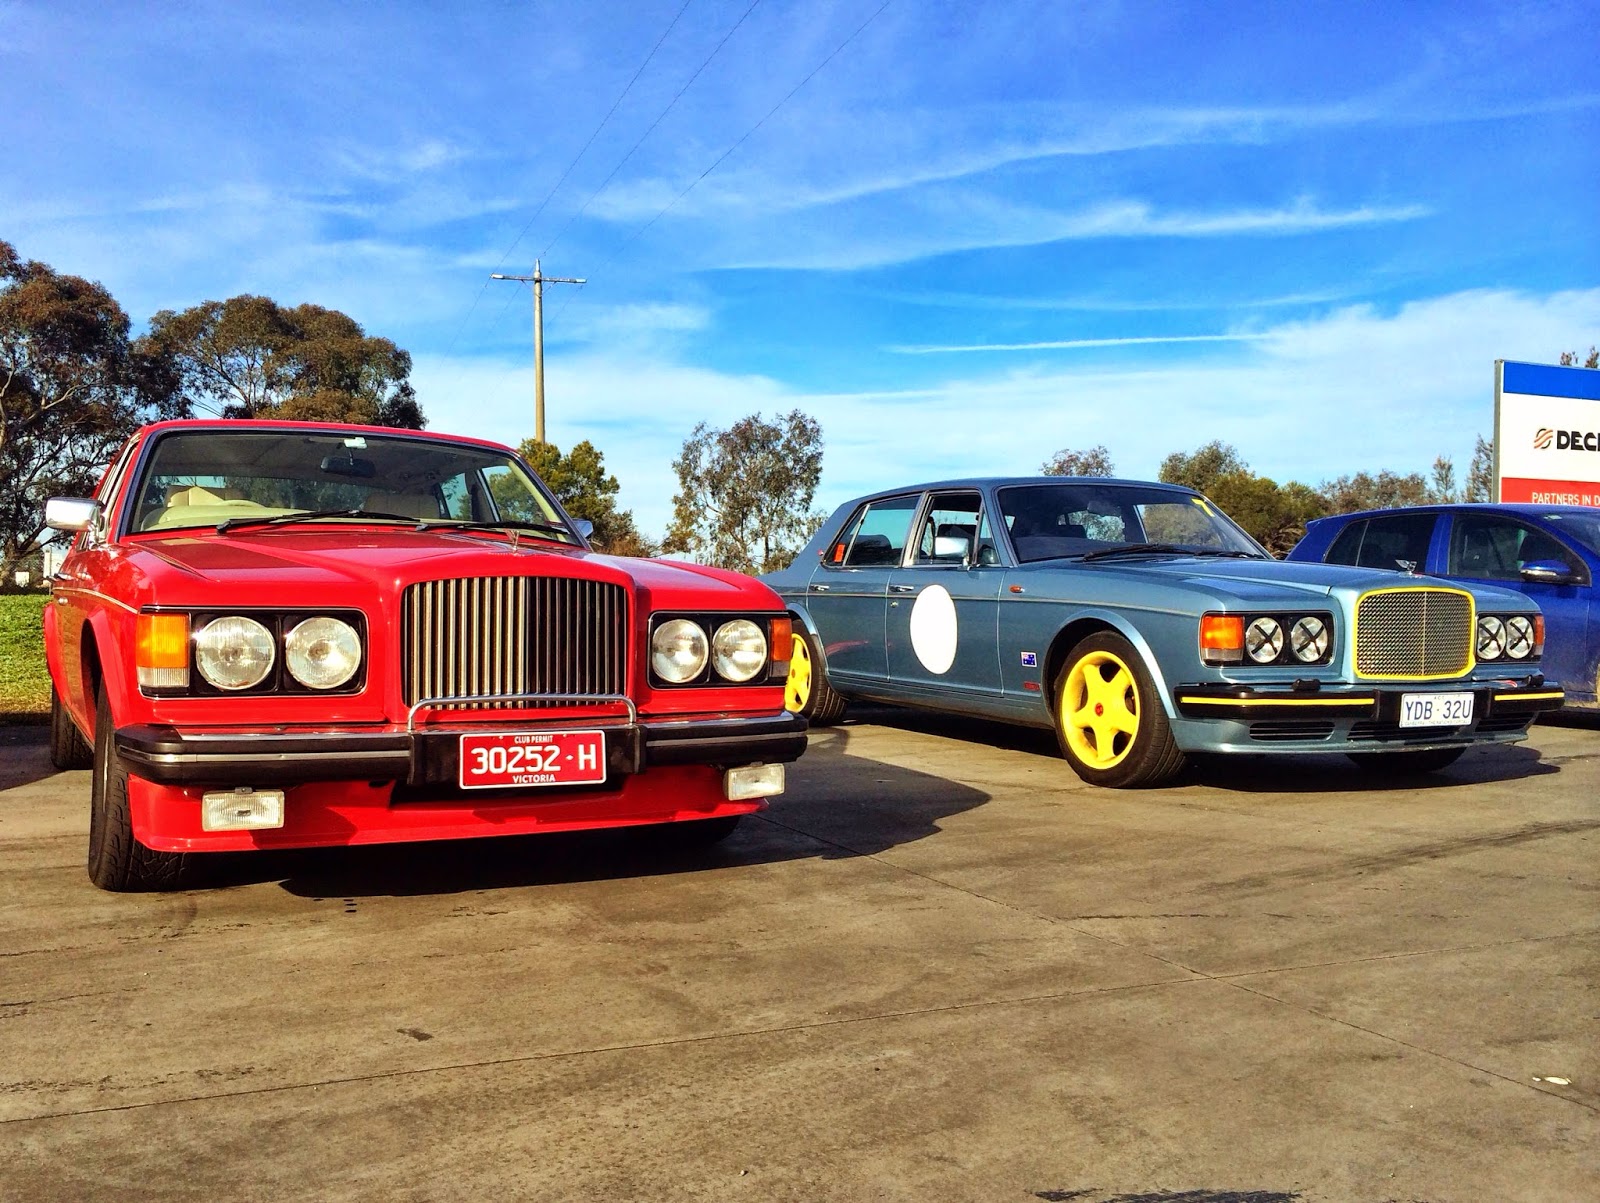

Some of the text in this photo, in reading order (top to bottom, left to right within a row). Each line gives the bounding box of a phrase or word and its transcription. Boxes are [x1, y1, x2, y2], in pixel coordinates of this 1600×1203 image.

[1557, 430, 1600, 452] DEC
[1532, 491, 1580, 506] PARTNERS
[1582, 494, 1592, 506] IN
[1405, 699, 1472, 720] YDB 32U
[514, 735, 554, 744] CLUB PERMIT
[470, 744, 597, 774] 30252 H
[512, 774, 556, 783] VICTORIA
